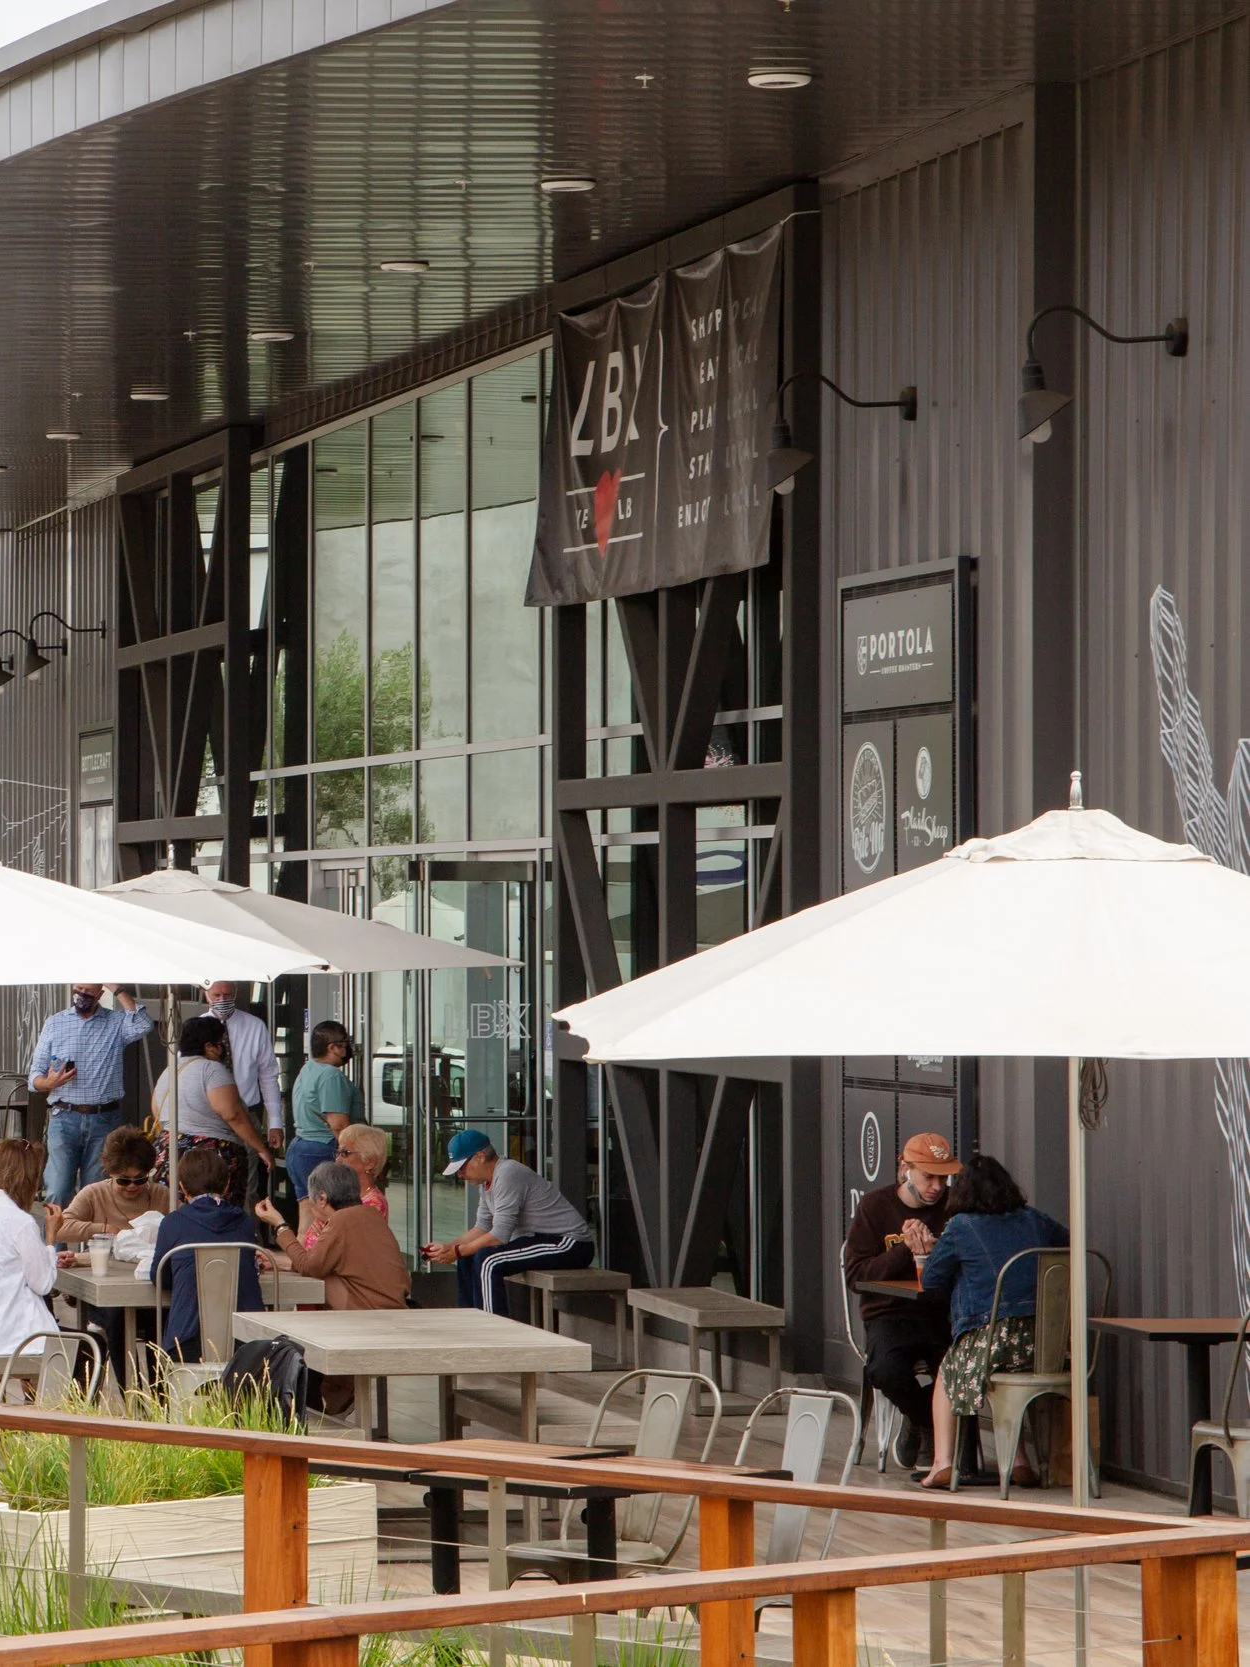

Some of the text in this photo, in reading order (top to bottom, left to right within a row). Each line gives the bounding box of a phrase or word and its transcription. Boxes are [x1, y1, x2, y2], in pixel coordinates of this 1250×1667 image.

[731, 294, 764, 321] OCA
[570, 341, 648, 457] LBX
[618, 497, 632, 520] LB
[869, 625, 934, 661] PORTOLA
